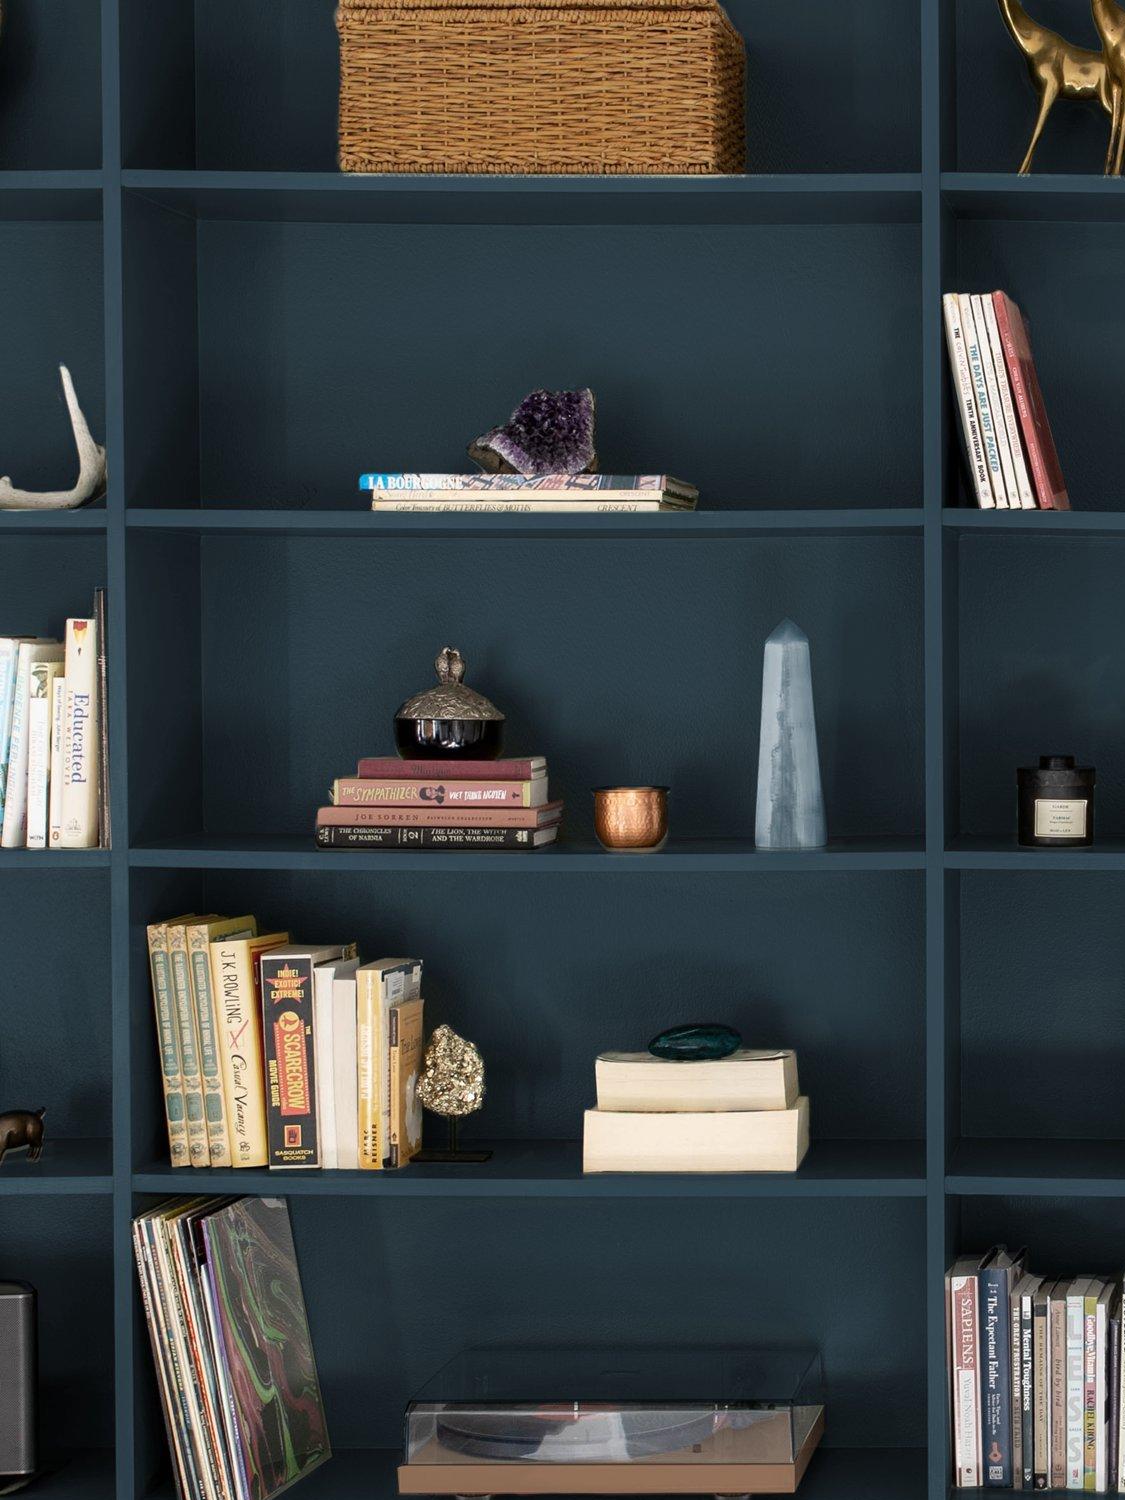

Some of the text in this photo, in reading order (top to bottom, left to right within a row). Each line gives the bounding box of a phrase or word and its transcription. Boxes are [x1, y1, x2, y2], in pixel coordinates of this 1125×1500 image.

[966, 399, 975, 418] TENTH
[969, 344, 999, 472] THE DAYS ARE JUST PACKED
[970, 420, 983, 462] ANNIVERSARY
[368, 476, 464, 490] LA BOURGOGNE
[978, 465, 986, 482] BOOK
[70, 693, 89, 783] Educated
[342, 786, 418, 802] THE SYMPATHIZER
[408, 831, 418, 839] 2
[446, 828, 465, 836] LION,
[271, 989, 304, 999] EXTREME!
[274, 979, 301, 988] EXOTIC!
[268, 1060, 280, 1107] MOVIE GUIDE
[283, 1033, 306, 1109] SCARECROW
[231, 1054, 248, 1136] Casual Vacancy
[961, 1297, 973, 1363] SAPIENS
[985, 1296, 999, 1389] The Expectant Father
[1022, 1328, 1031, 1411] Mental Toughness
[1053, 1378, 1061, 1387] by
[1086, 1389, 1094, 1450] RACHEL KHONG
